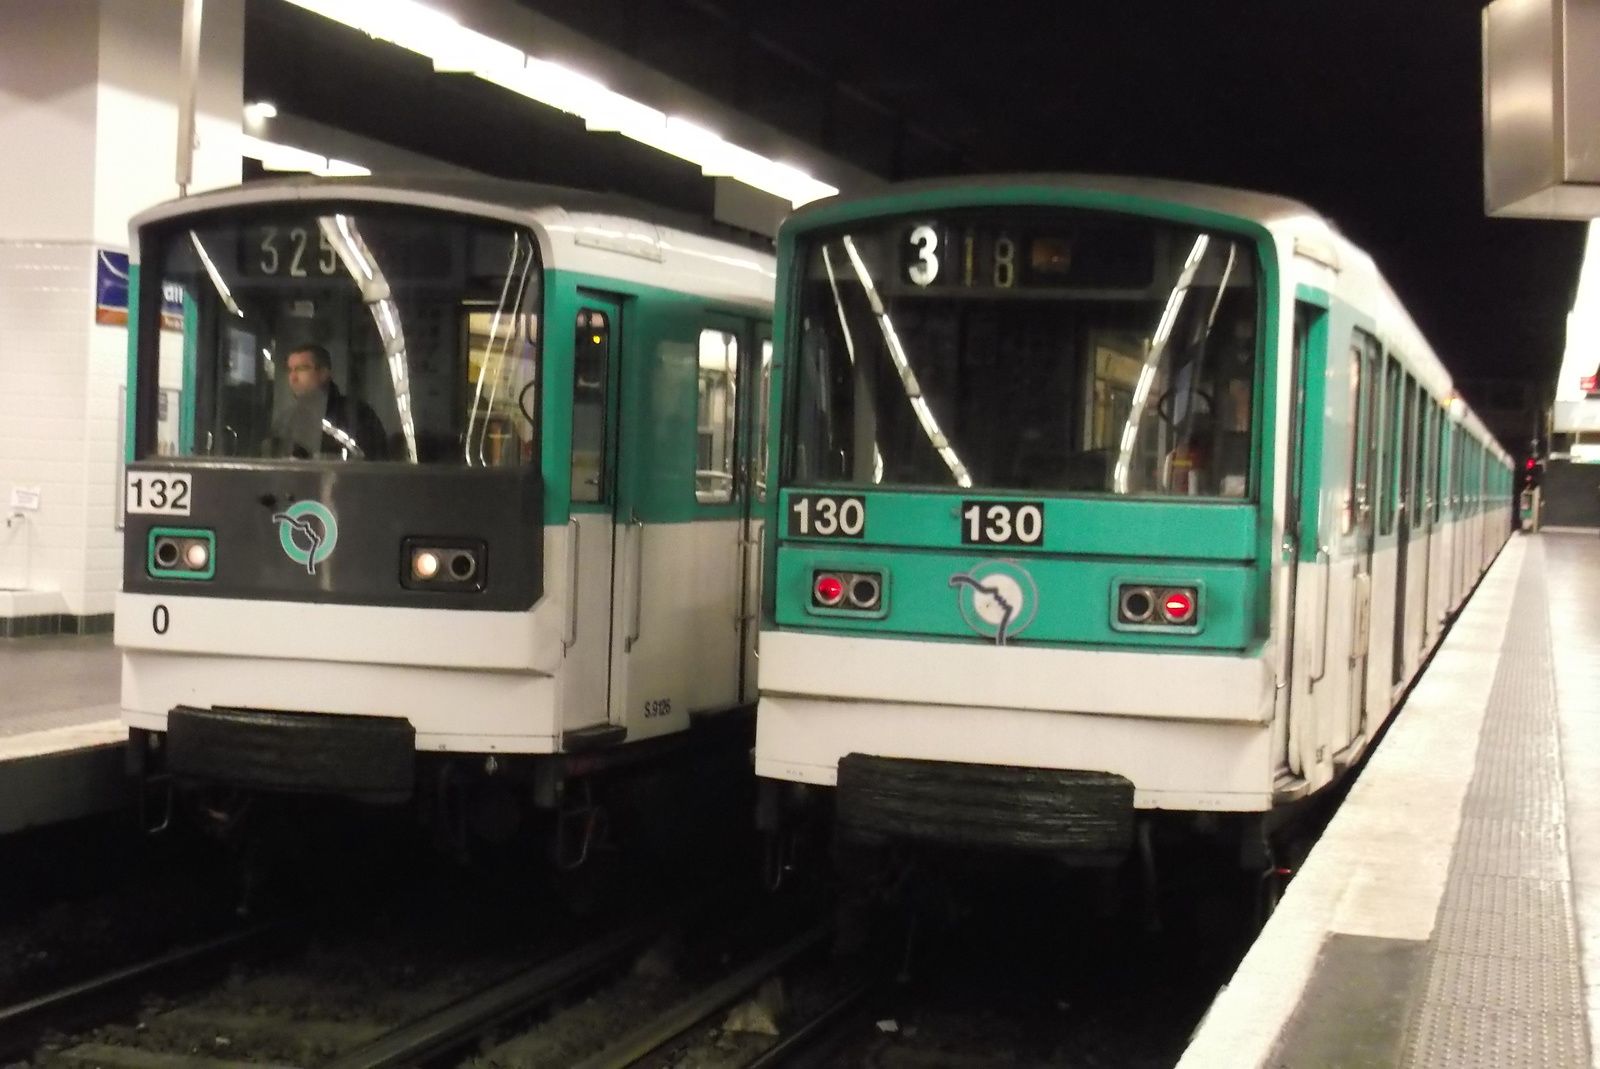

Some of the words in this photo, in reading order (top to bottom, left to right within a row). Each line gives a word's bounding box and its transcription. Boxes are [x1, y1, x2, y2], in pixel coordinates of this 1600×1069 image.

[908, 225, 940, 288] 3
[130, 478, 189, 510] 132
[793, 498, 865, 536] 130
[964, 505, 1043, 543] 130
[152, 604, 170, 634] 0
